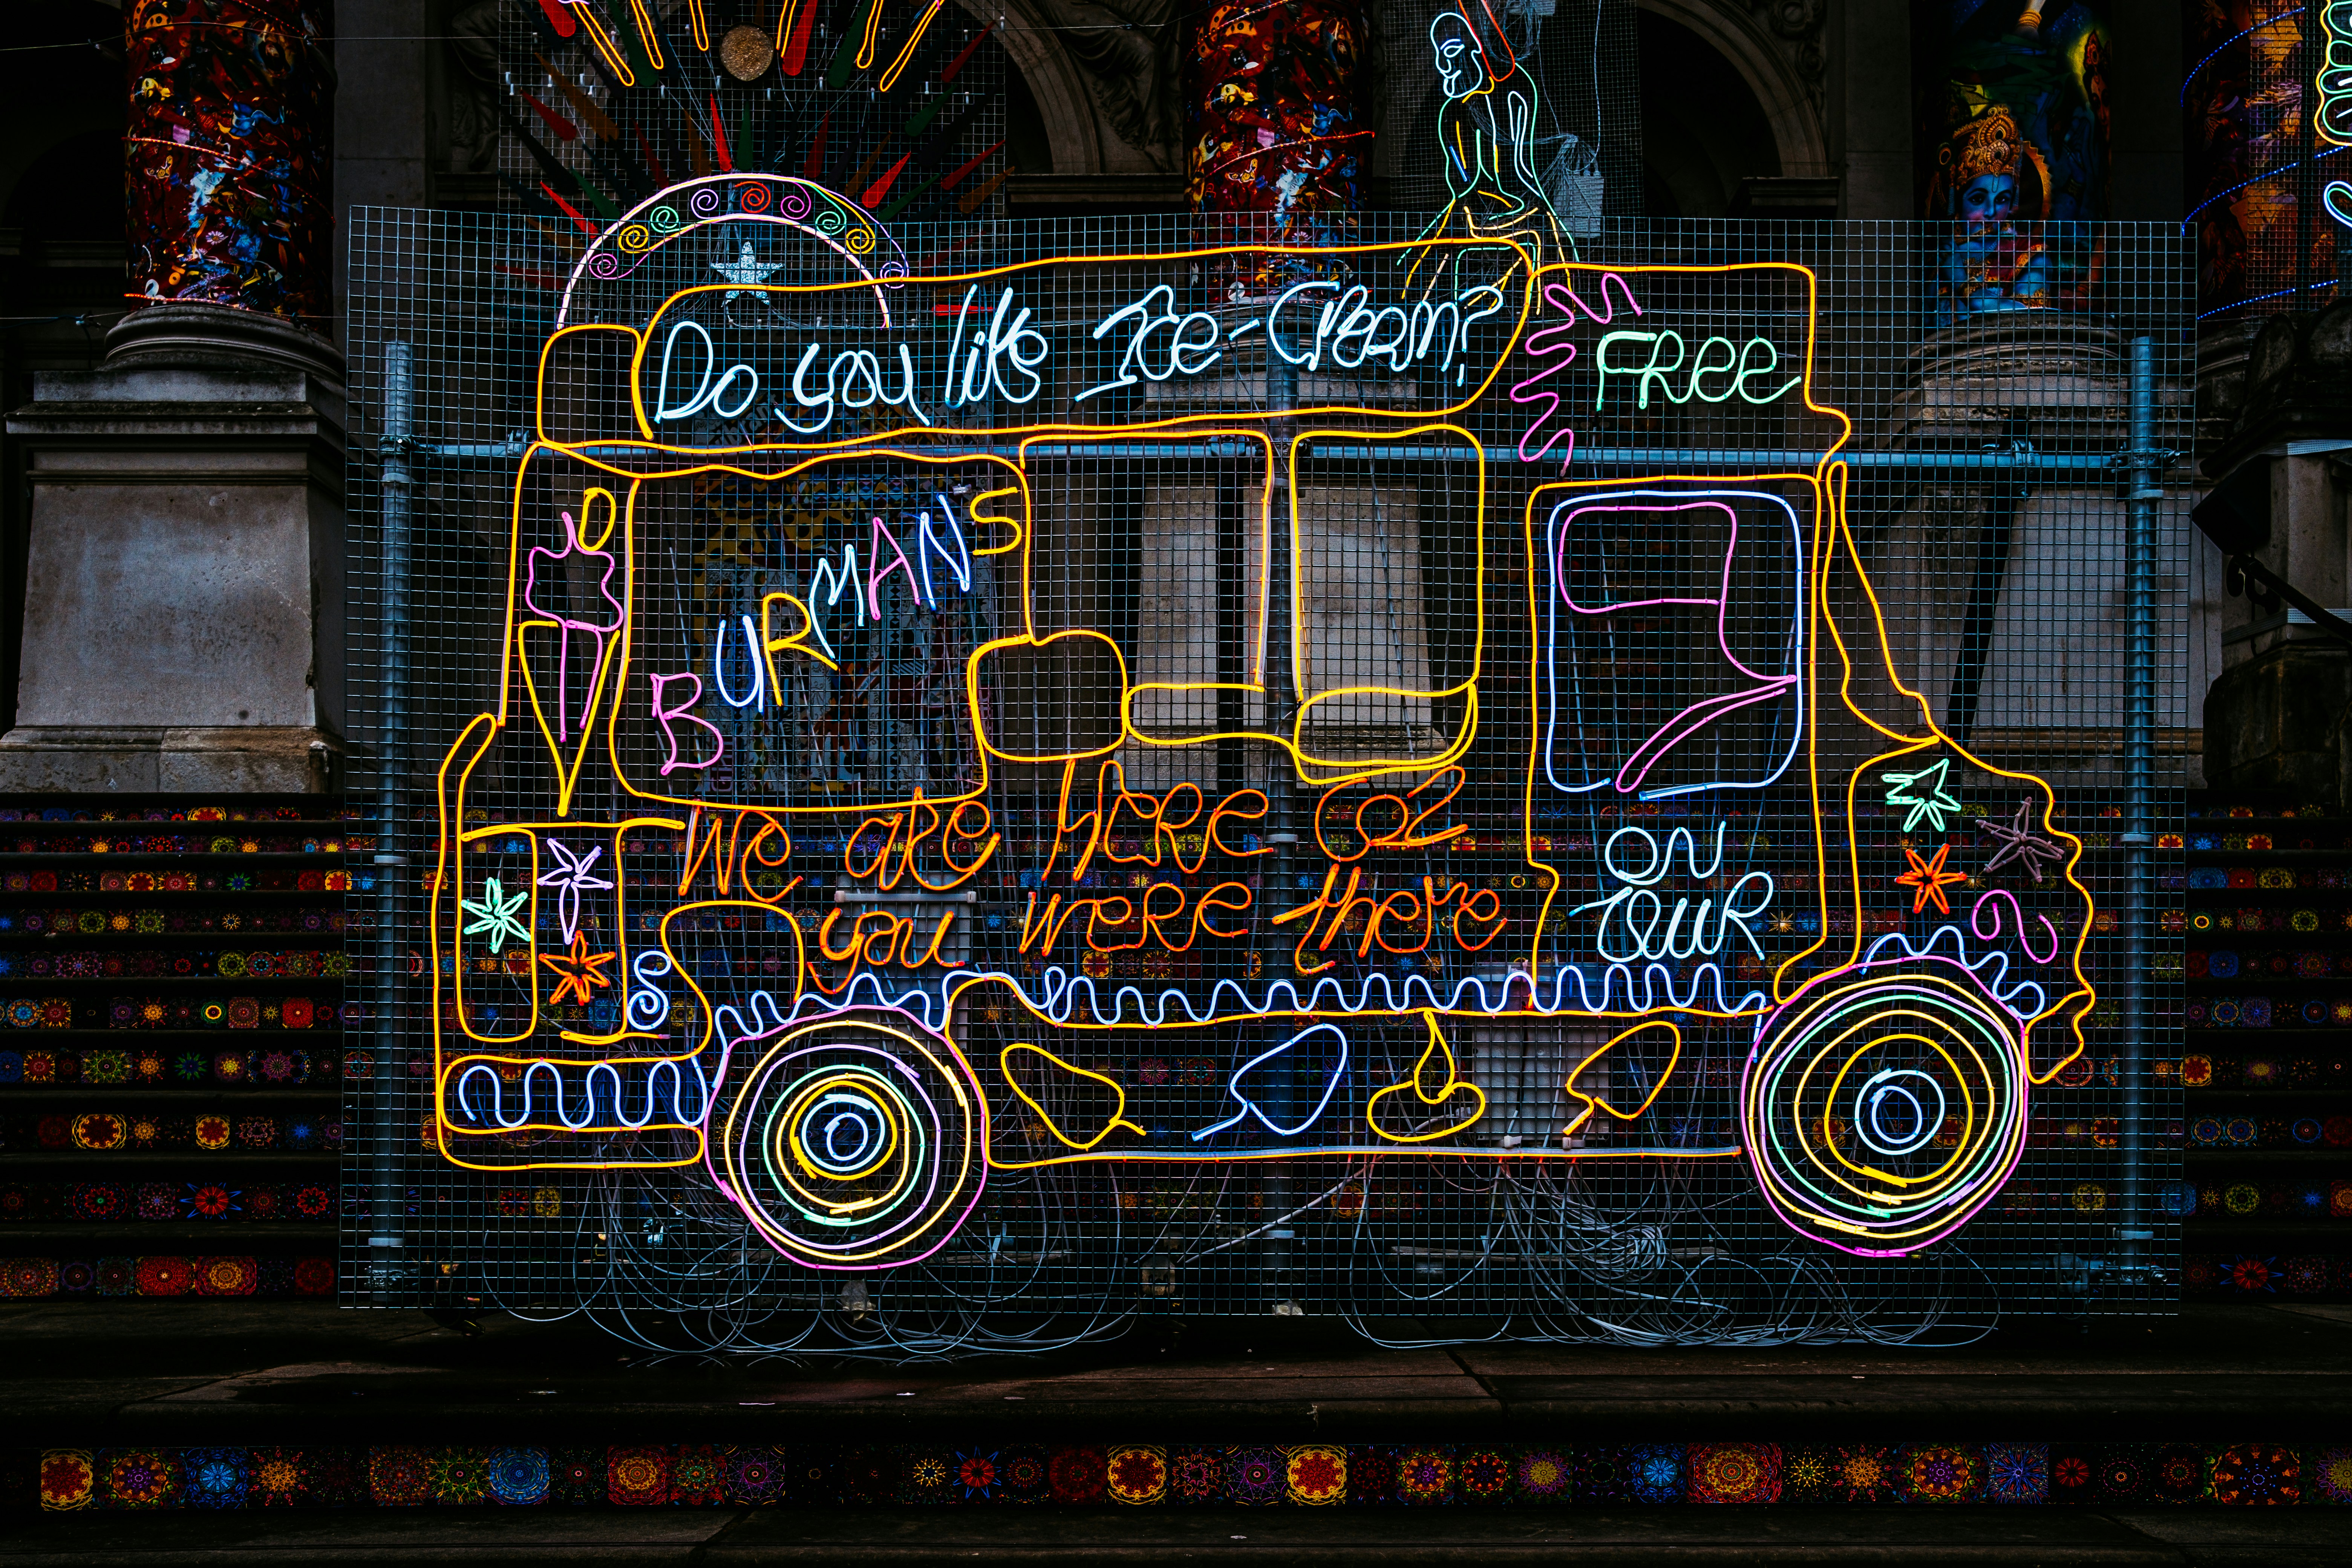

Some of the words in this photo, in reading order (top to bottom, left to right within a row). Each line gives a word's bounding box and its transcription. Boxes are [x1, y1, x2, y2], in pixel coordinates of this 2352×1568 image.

[655, 321, 758, 423] Do
[774, 343, 930, 433] you
[945, 284, 1048, 409] like
[650, 486, 1021, 775] BURMANS
[678, 799, 804, 903] We
[807, 908, 965, 995] you
